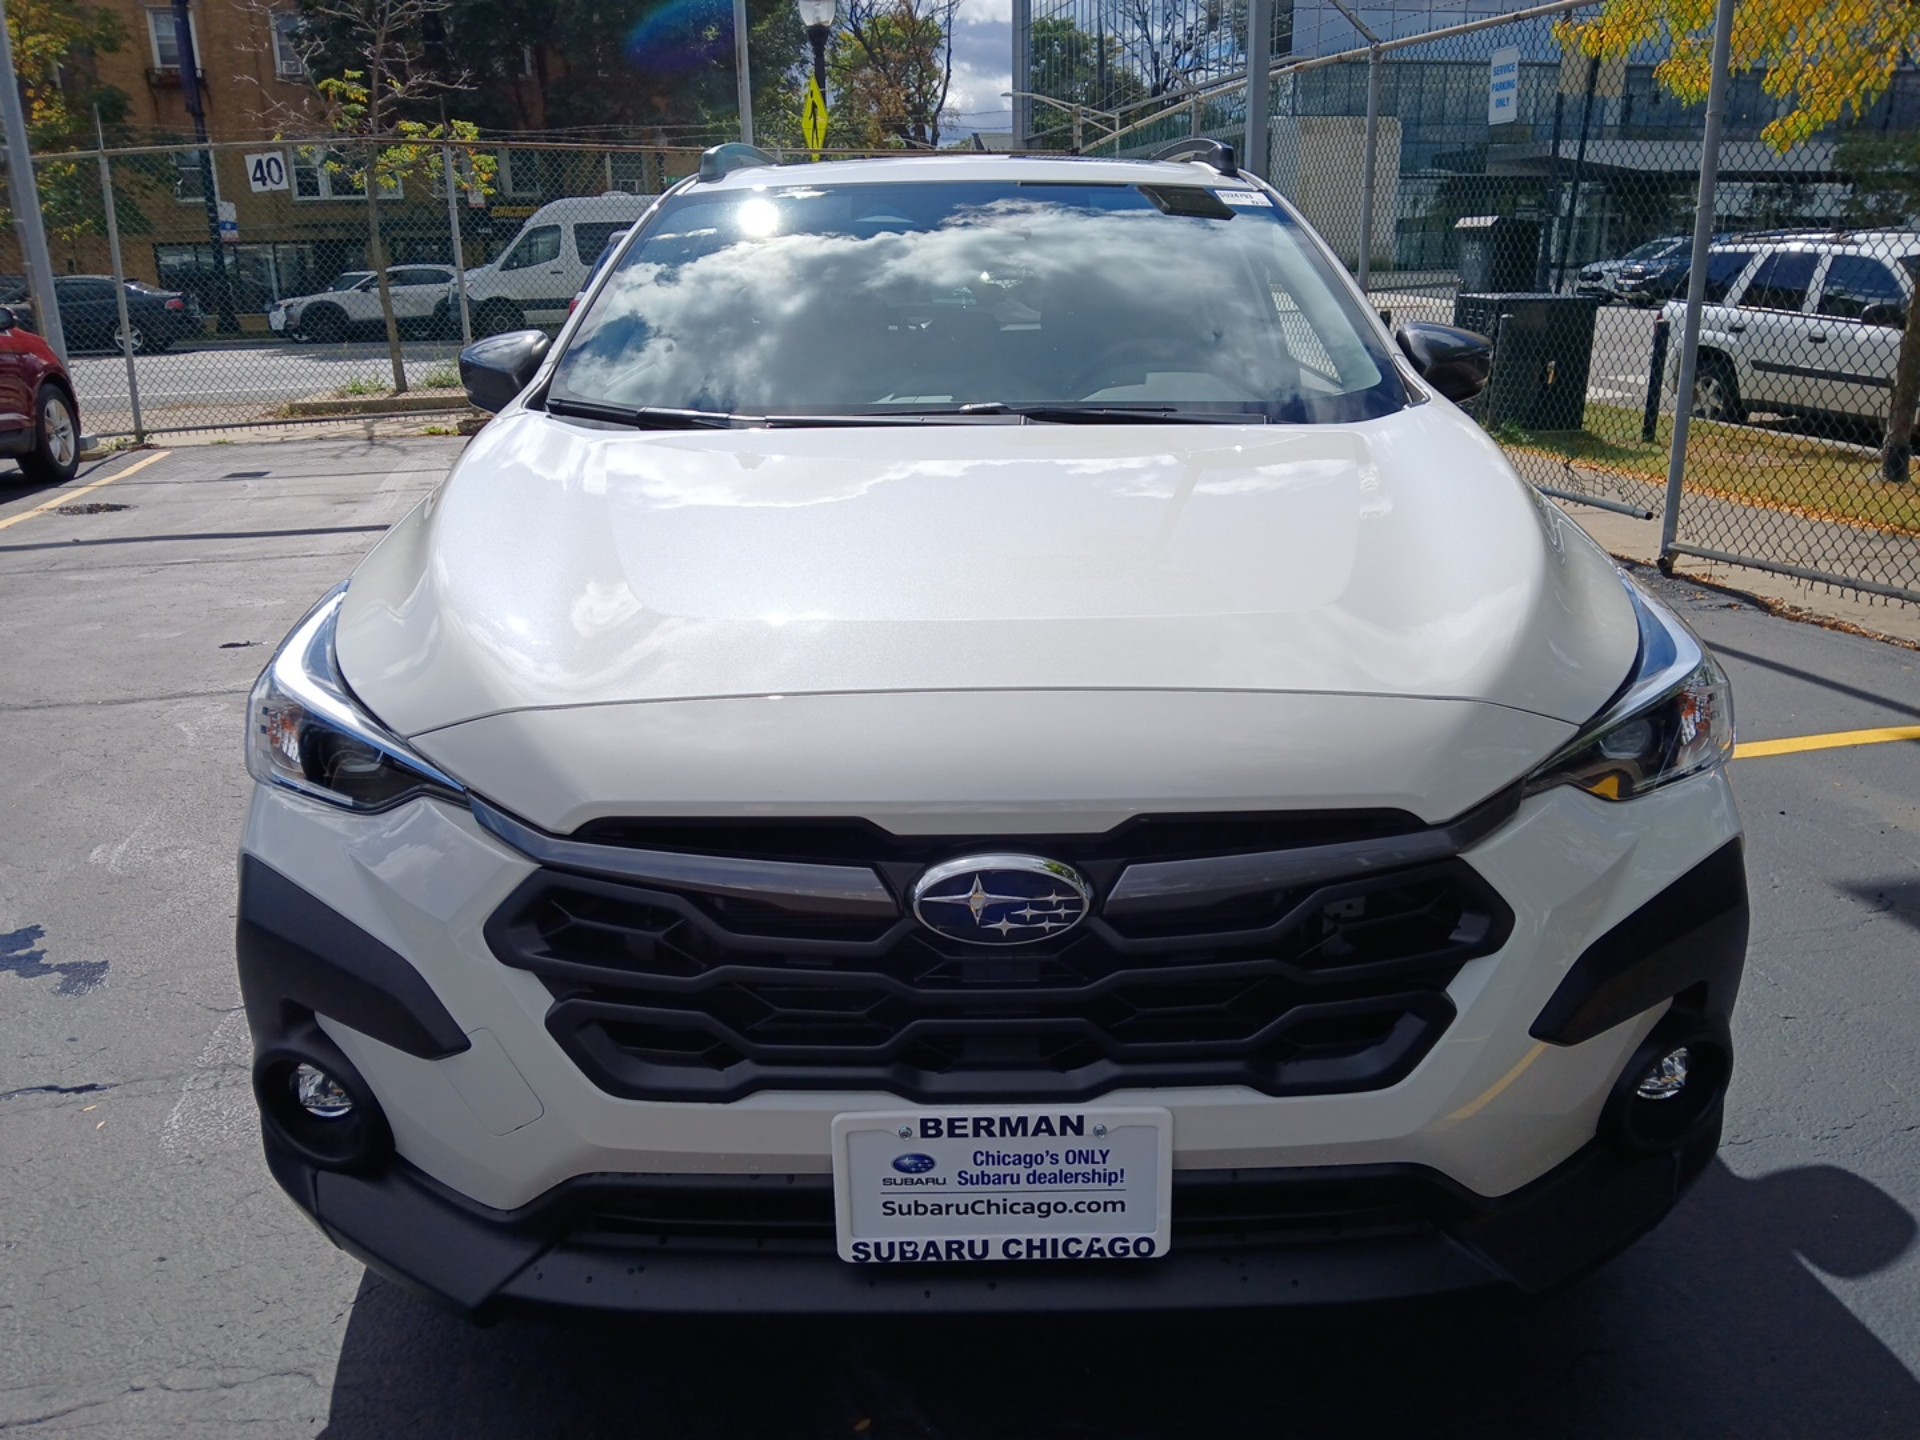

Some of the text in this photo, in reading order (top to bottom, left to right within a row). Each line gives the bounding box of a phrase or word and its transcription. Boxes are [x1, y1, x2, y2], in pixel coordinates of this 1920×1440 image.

[1493, 62, 1516, 76] SERVICE
[1492, 79, 1516, 93] PARKING
[1495, 97, 1510, 109] ONLY
[252, 157, 283, 187] 40
[919, 1114, 1085, 1139] BERMAN
[972, 1149, 1111, 1169] Chicago's ONLY
[882, 1177, 947, 1186] SUBARU
[957, 1168, 1125, 1186] Subaru dealership!
[882, 1199, 1126, 1219] SubaruChicago.com
[851, 1236, 1156, 1263] SUBARU CHICAGO
